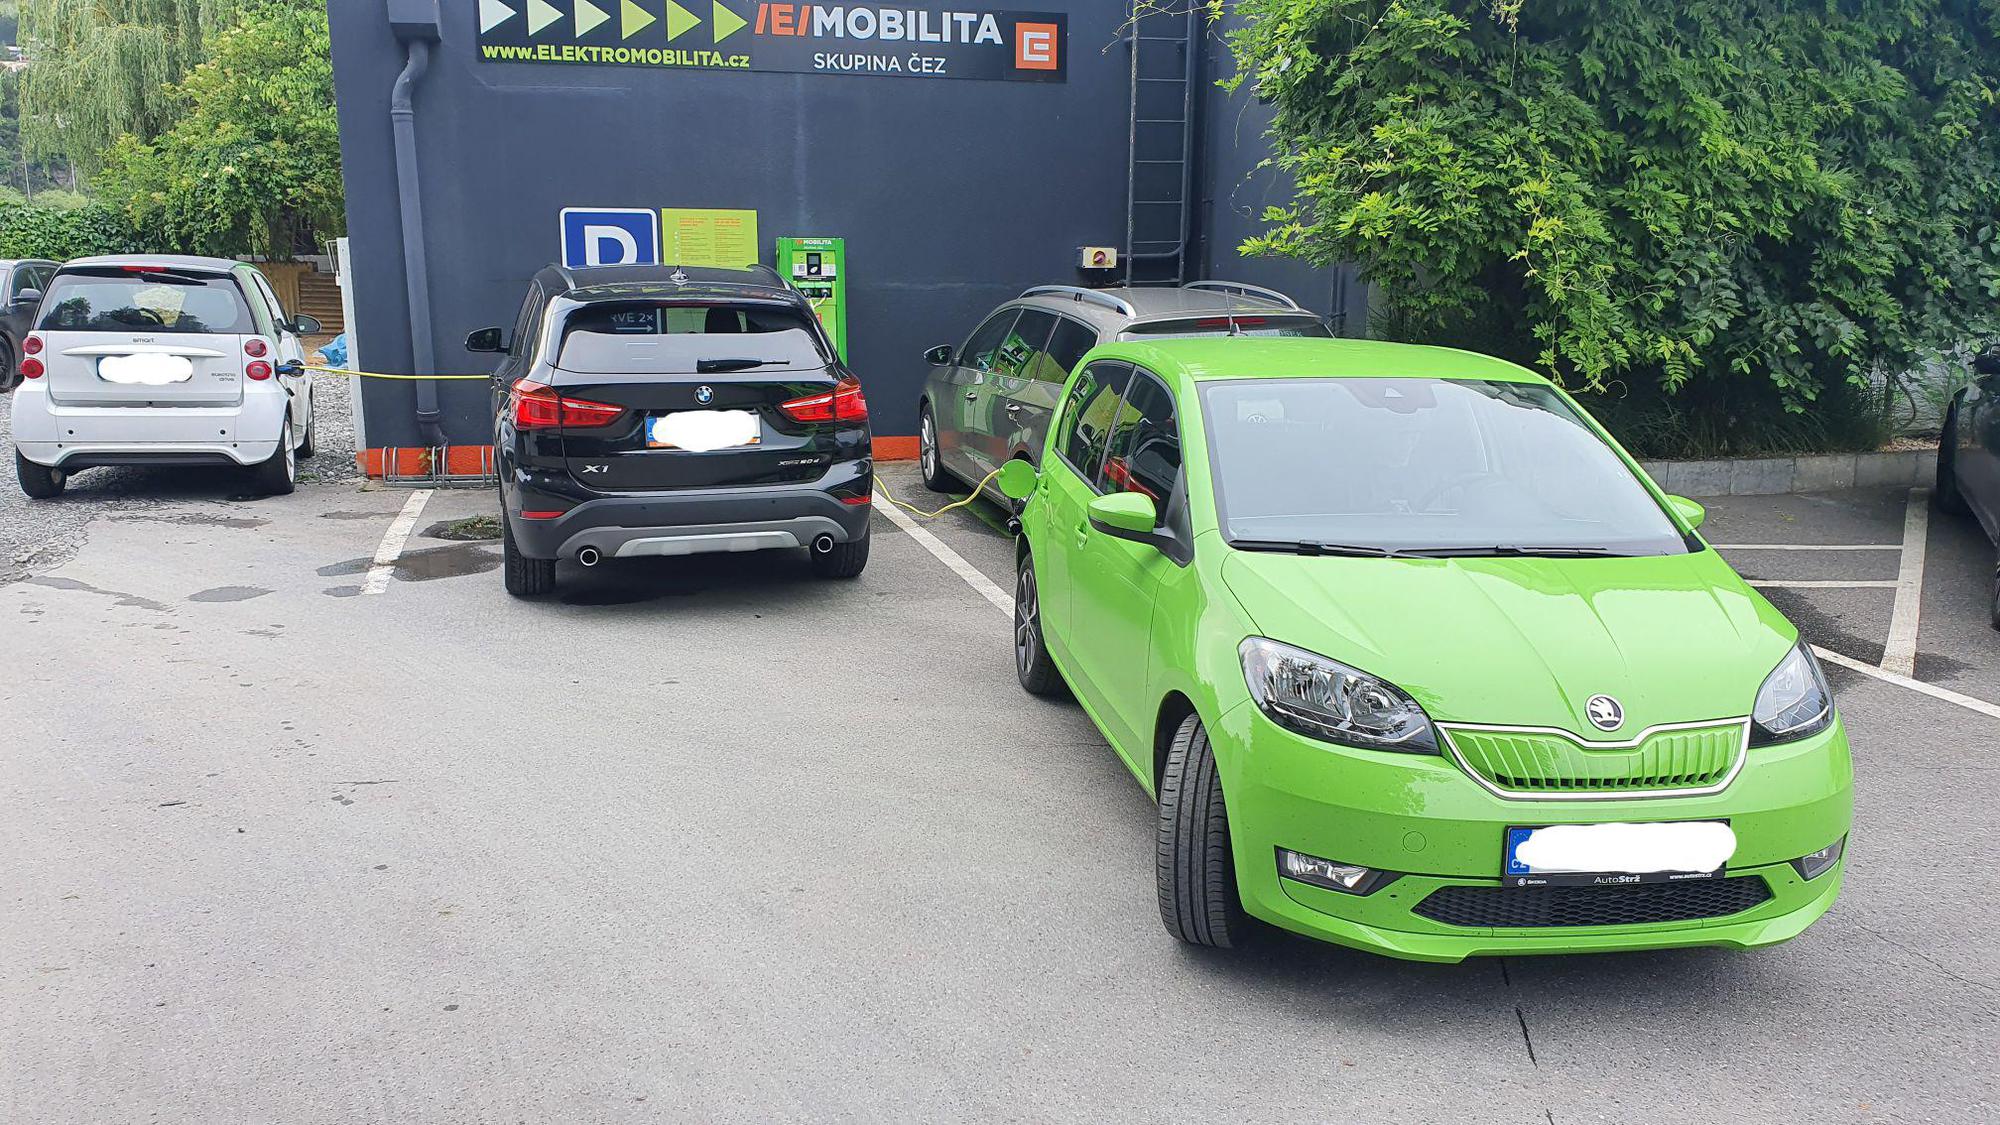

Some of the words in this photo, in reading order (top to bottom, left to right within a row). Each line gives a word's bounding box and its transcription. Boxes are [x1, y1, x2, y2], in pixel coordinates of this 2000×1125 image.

[481, 44, 750, 68] www.ELEKTROMOBILITA.cz
[813, 53, 902, 72] SKUPINA
[907, 52, 946, 74] ČEZ
[1594, 875, 1641, 884] AutoStrž
